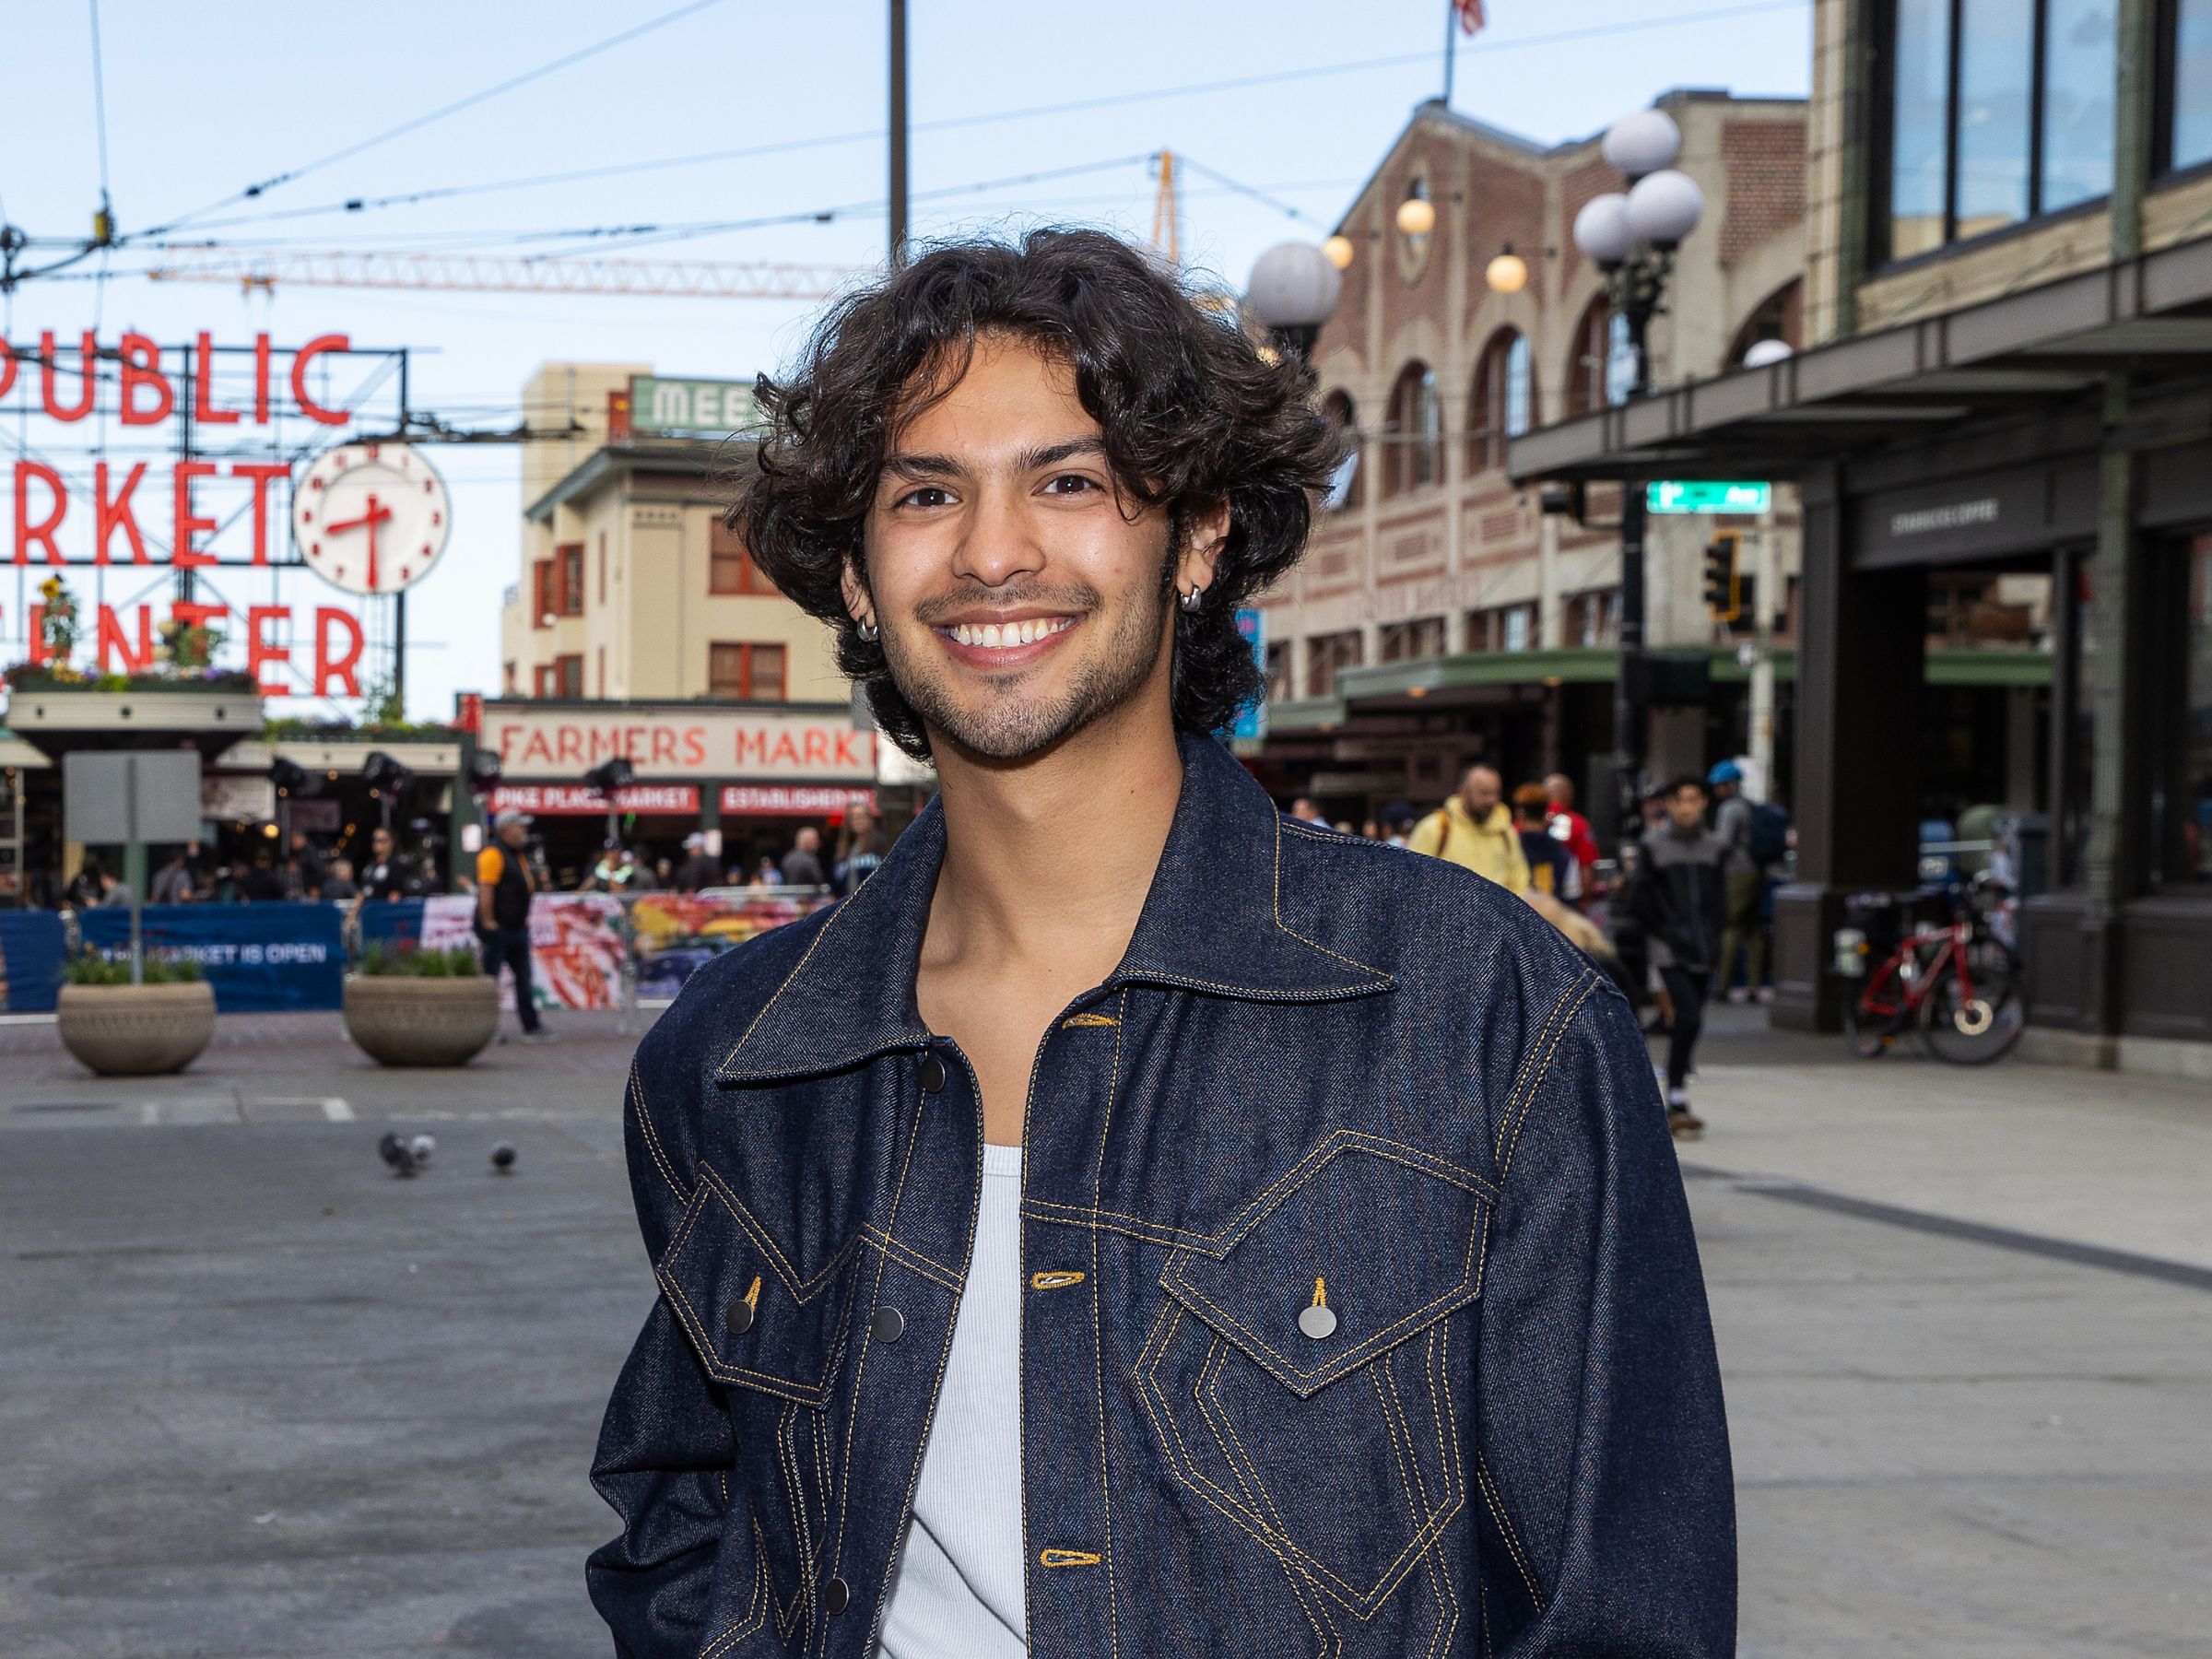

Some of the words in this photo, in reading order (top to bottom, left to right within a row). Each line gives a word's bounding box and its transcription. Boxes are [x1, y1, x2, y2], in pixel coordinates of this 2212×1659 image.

[14, 460, 291, 565] RKET
[0, 604, 365, 698] NTER
[501, 724, 706, 766] FARMERS
[495, 787, 539, 808] PIKE
[241, 944, 264, 965] IS
[265, 943, 326, 963] OPEN
